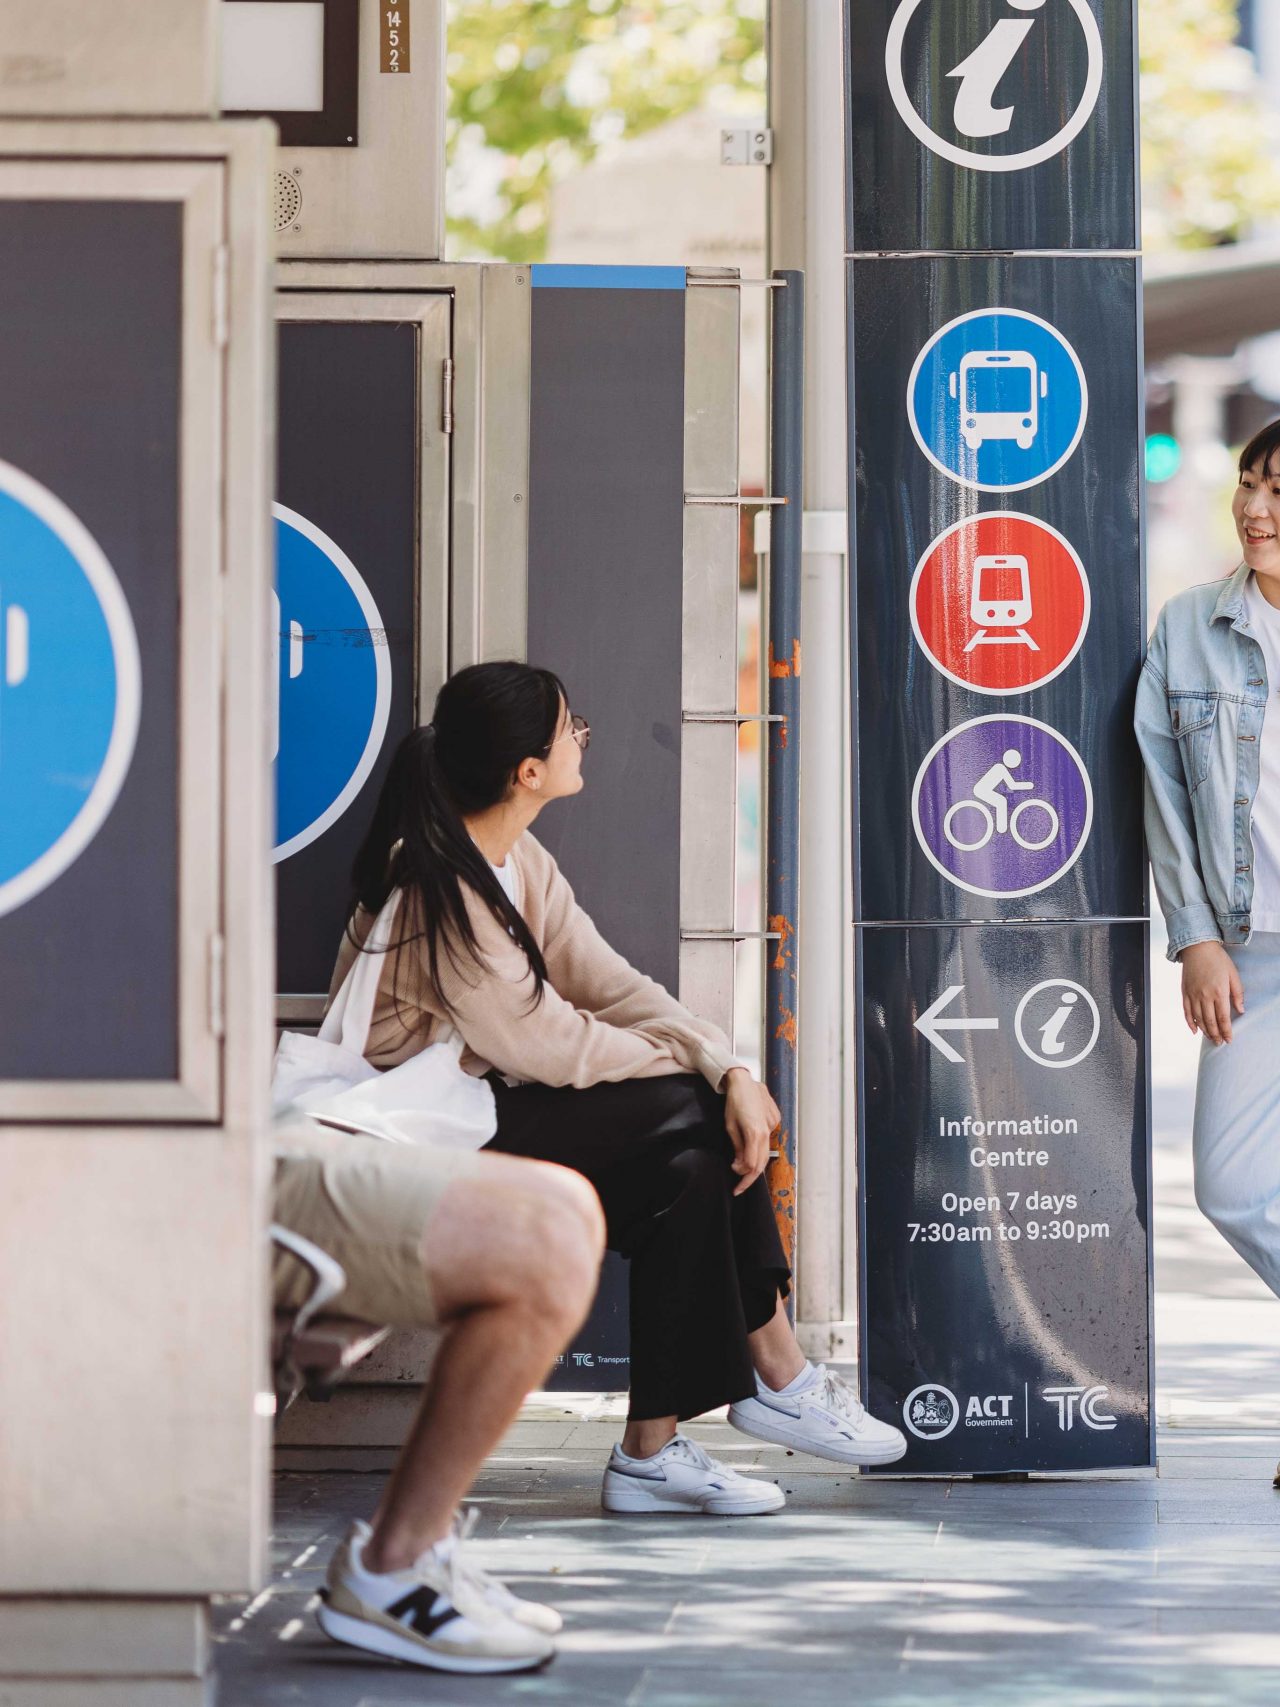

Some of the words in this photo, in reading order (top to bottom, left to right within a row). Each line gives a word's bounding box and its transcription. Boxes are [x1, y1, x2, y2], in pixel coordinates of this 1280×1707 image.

[386, 11, 401, 27] 14
[389, 30, 399, 46] 5
[389, 49, 399, 65] 2
[939, 1115, 1078, 1137] Information
[970, 1147, 1049, 1168] Centre
[941, 1192, 1000, 1216] Open
[1006, 1191, 1020, 1211] 7
[1025, 1190, 1078, 1215] days
[906, 1222, 992, 1242] 7:30am
[999, 1224, 1021, 1242] to
[1026, 1220, 1110, 1243] 9:30pm
[572, 1353, 594, 1367] TC
[598, 1356, 630, 1365] Transport
[965, 1395, 1013, 1417] ACT
[1042, 1385, 1118, 1432] TC
[965, 1417, 1014, 1427] Government
[384, 1585, 463, 1637] N
